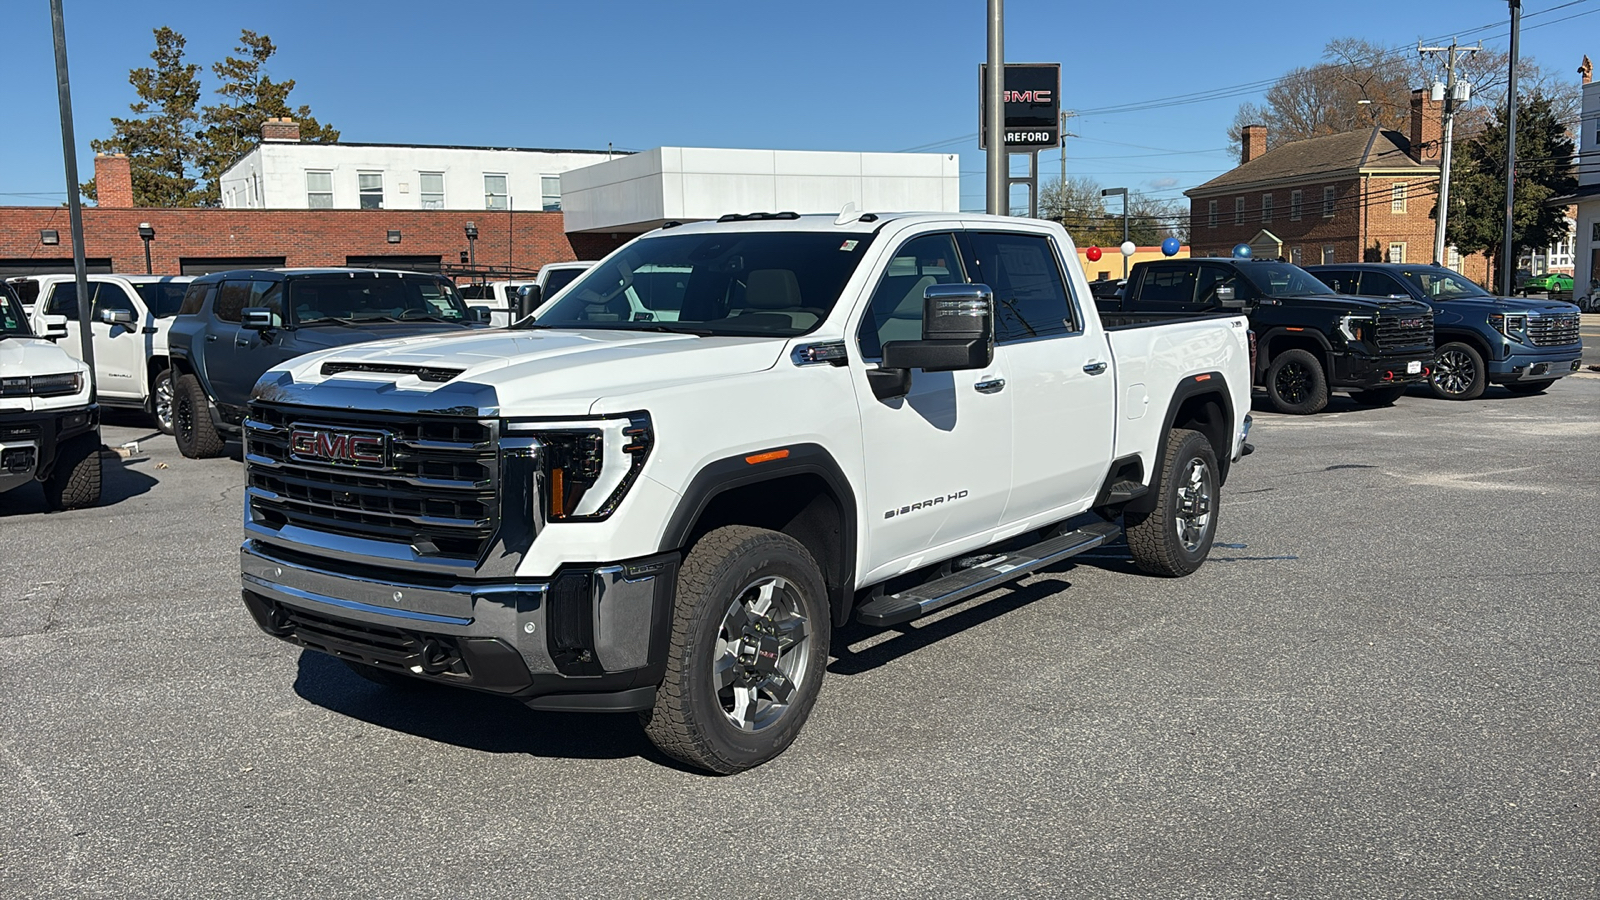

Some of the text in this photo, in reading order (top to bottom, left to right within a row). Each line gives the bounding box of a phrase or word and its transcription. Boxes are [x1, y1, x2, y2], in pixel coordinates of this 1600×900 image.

[291, 429, 383, 464] GMC
[883, 489, 969, 519] SIERRA HD
